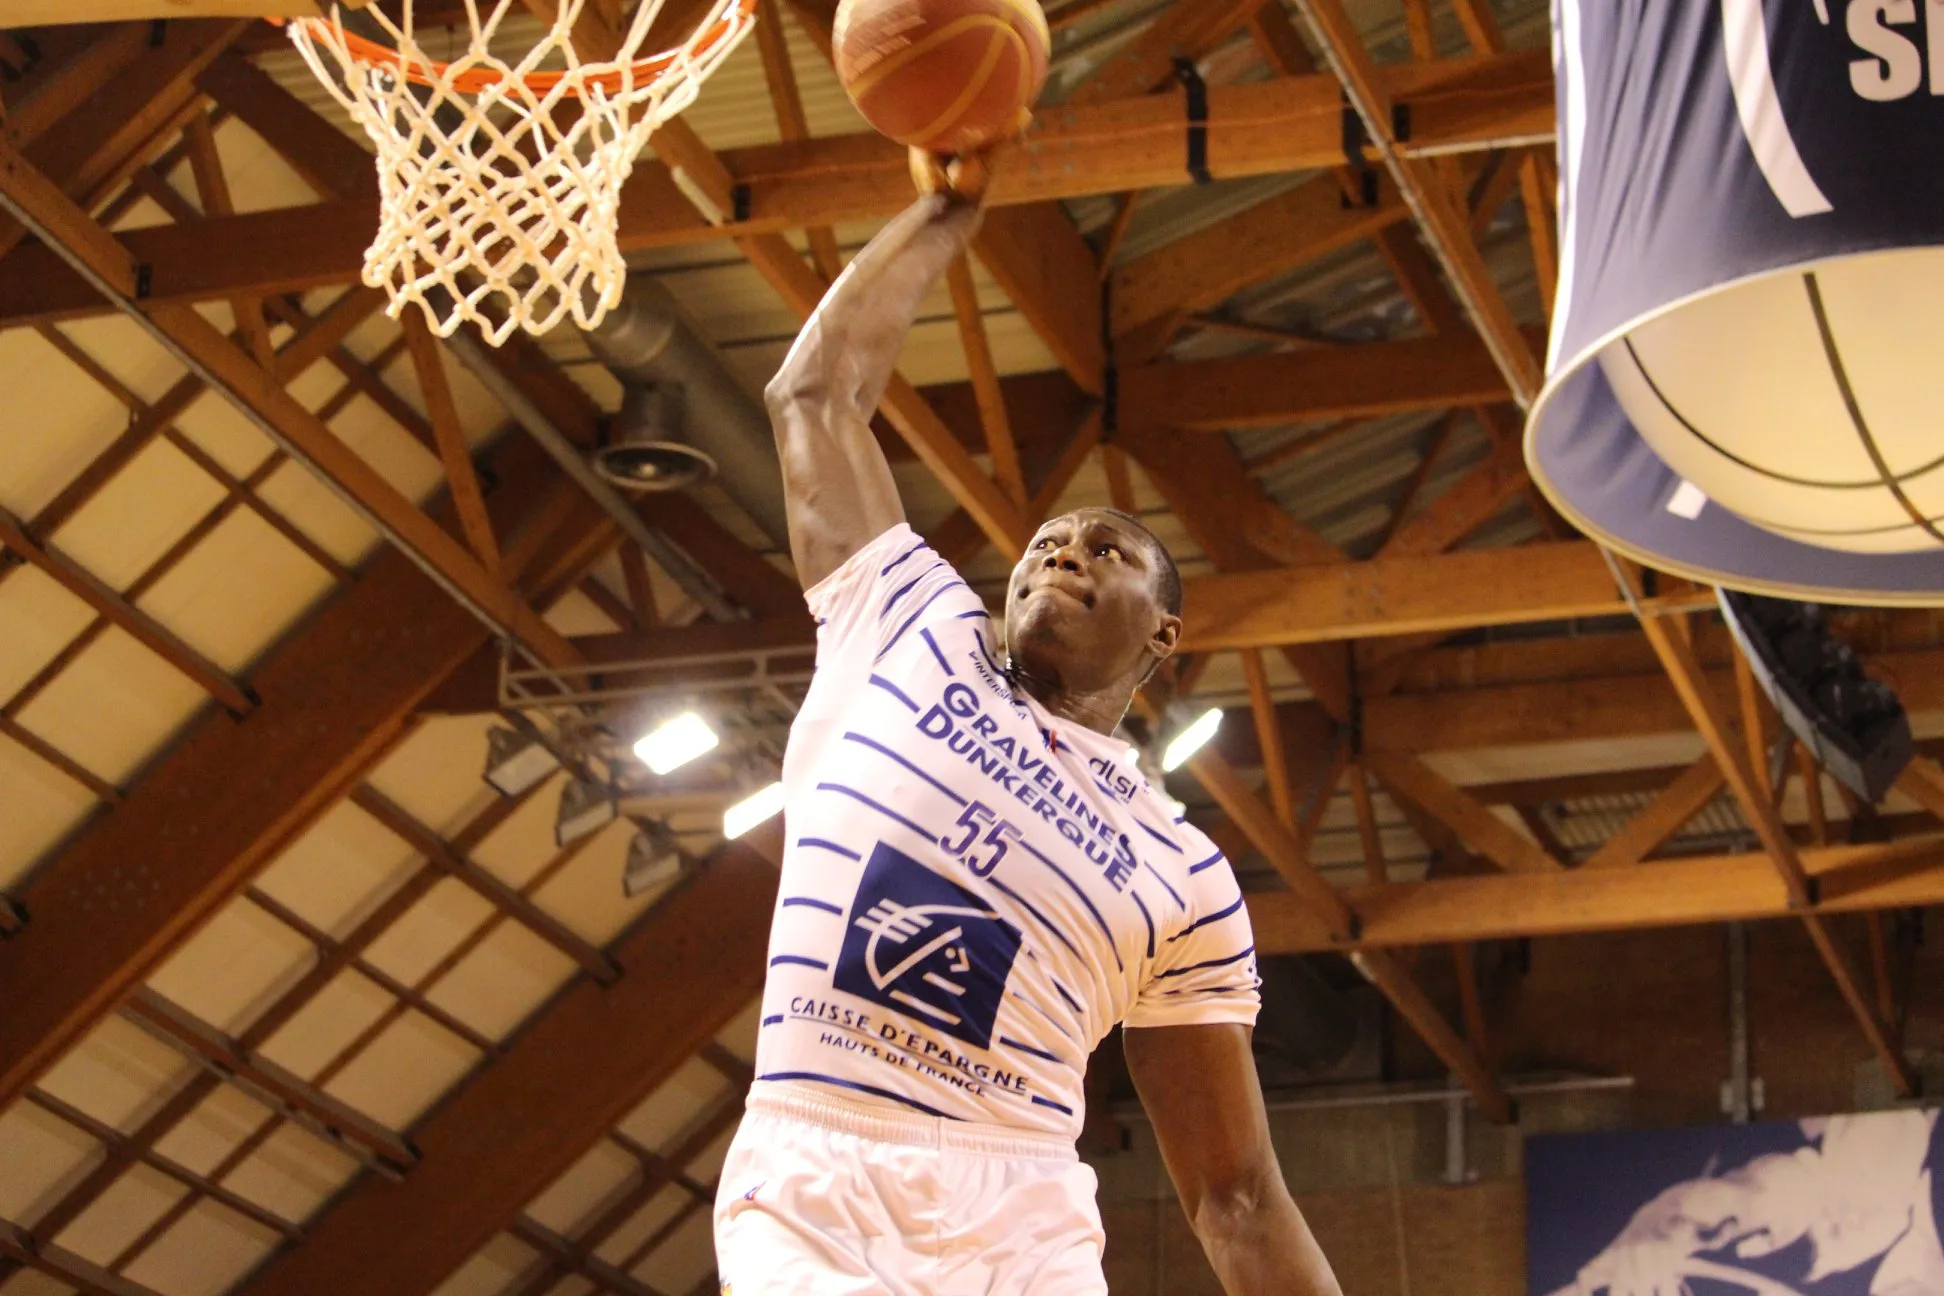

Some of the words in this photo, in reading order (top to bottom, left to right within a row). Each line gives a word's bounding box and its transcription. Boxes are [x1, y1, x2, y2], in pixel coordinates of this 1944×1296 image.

[974, 661, 1027, 720] INTERSP
[915, 703, 1133, 894] DUNKERQUE
[943, 682, 1138, 870] GRAVELINES
[939, 799, 1024, 878] 55
[790, 996, 871, 1032] CAISSE
[880, 1023, 1029, 1092] D'EPARGNE
[820, 1031, 879, 1058] HAUTS
[885, 1052, 910, 1069] DE
[915, 1063, 986, 1099] FRANCE
